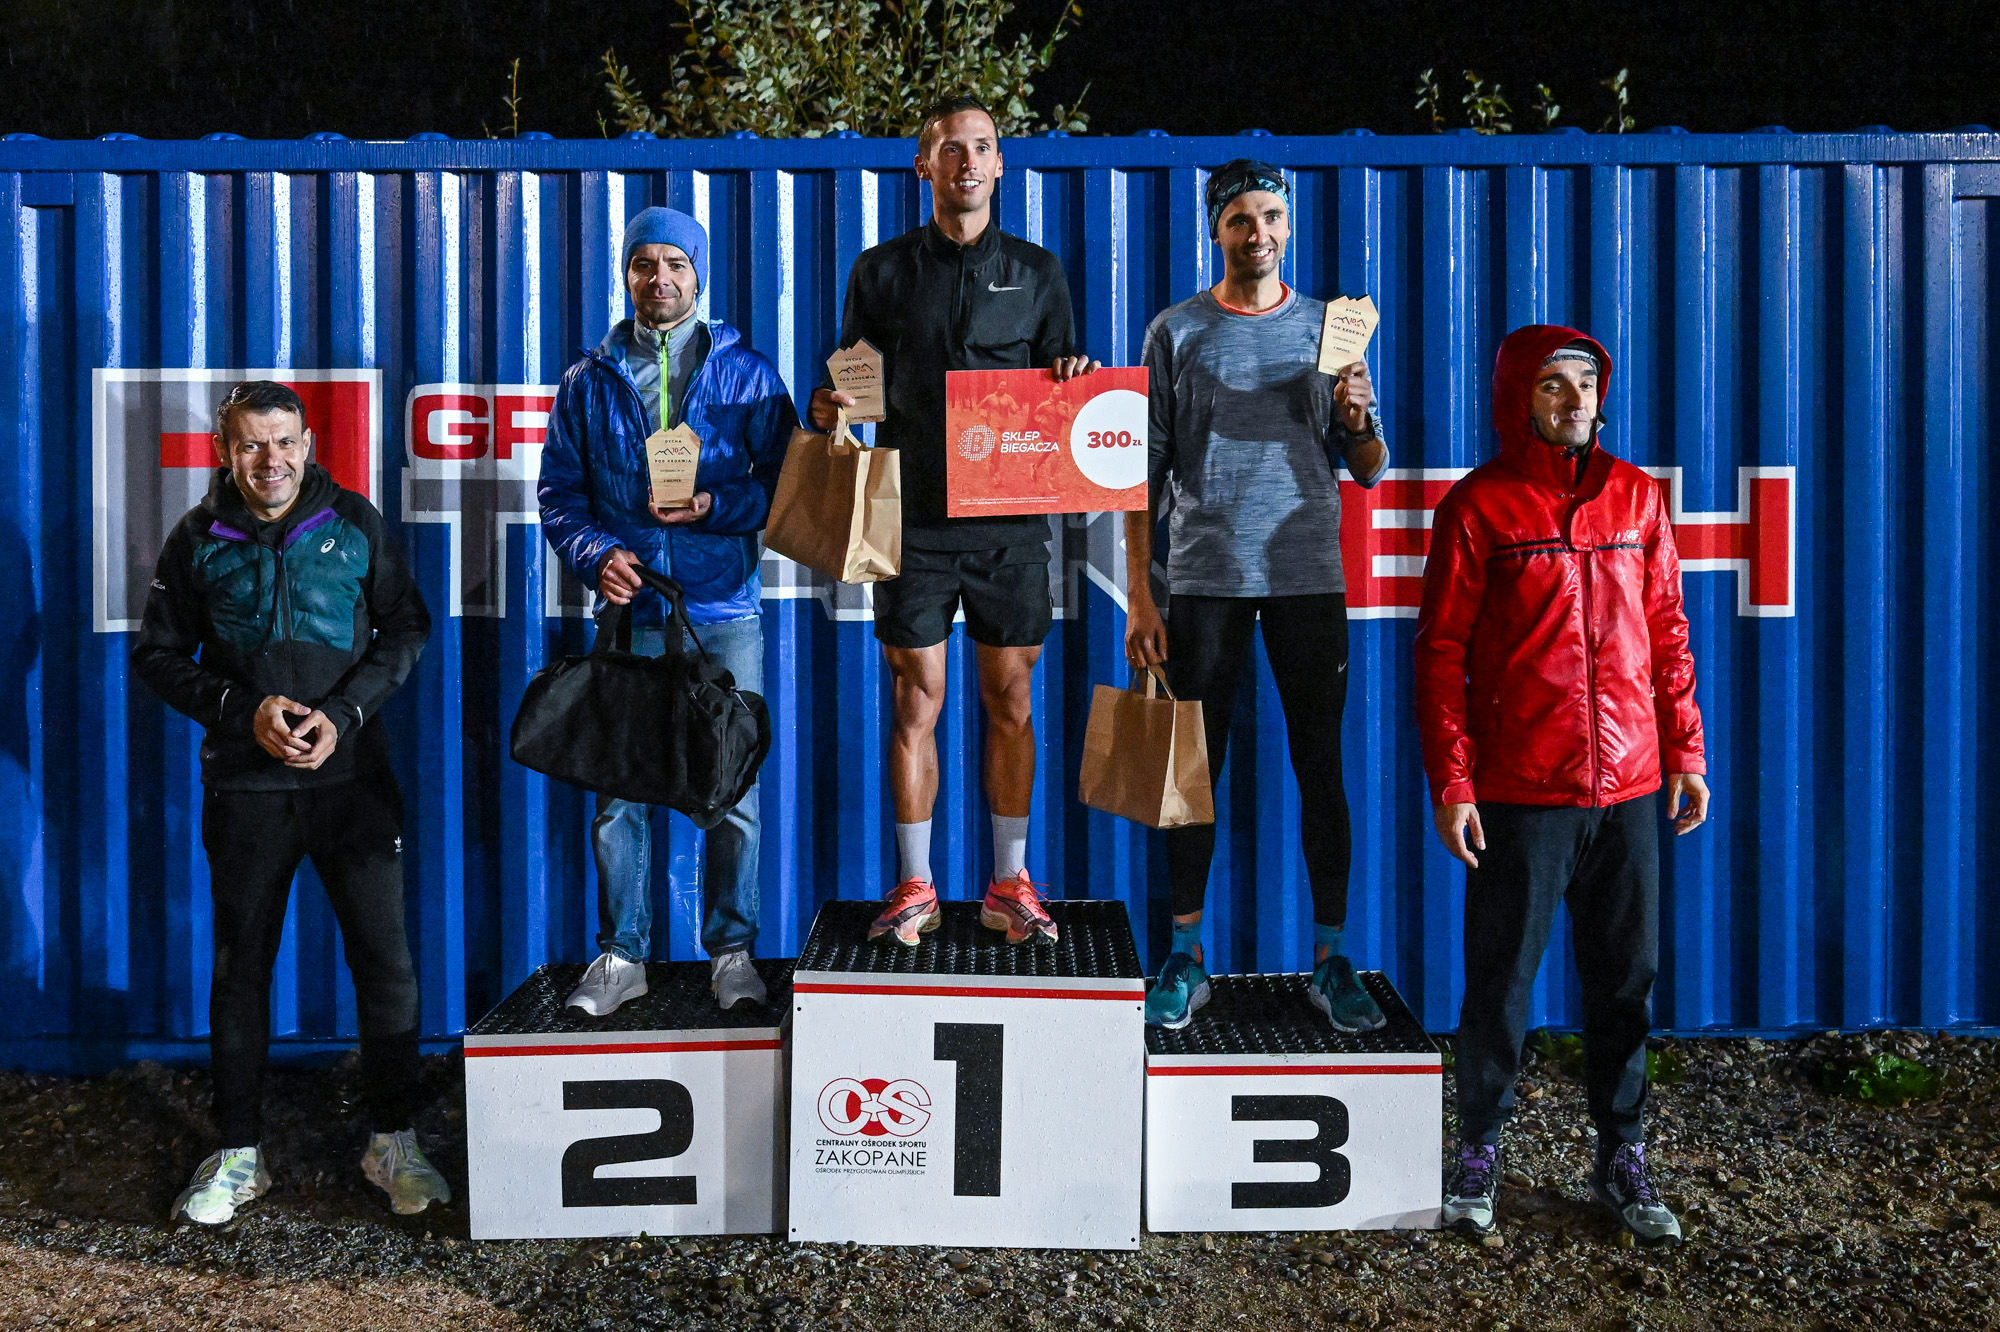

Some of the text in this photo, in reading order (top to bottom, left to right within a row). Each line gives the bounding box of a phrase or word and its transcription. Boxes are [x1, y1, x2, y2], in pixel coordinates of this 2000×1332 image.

[1000, 442, 1060, 454] BIEGACZA
[1002, 431, 1040, 442] SKLEP
[1086, 430, 1132, 449] 300
[934, 1023, 1004, 1196] 1
[562, 1080, 697, 1206] 2
[815, 1138, 927, 1148] CENTRALNY OŚRODEK SPORTU
[1231, 1094, 1351, 1209] 3
[815, 1149, 927, 1167] ZAKOPANE
